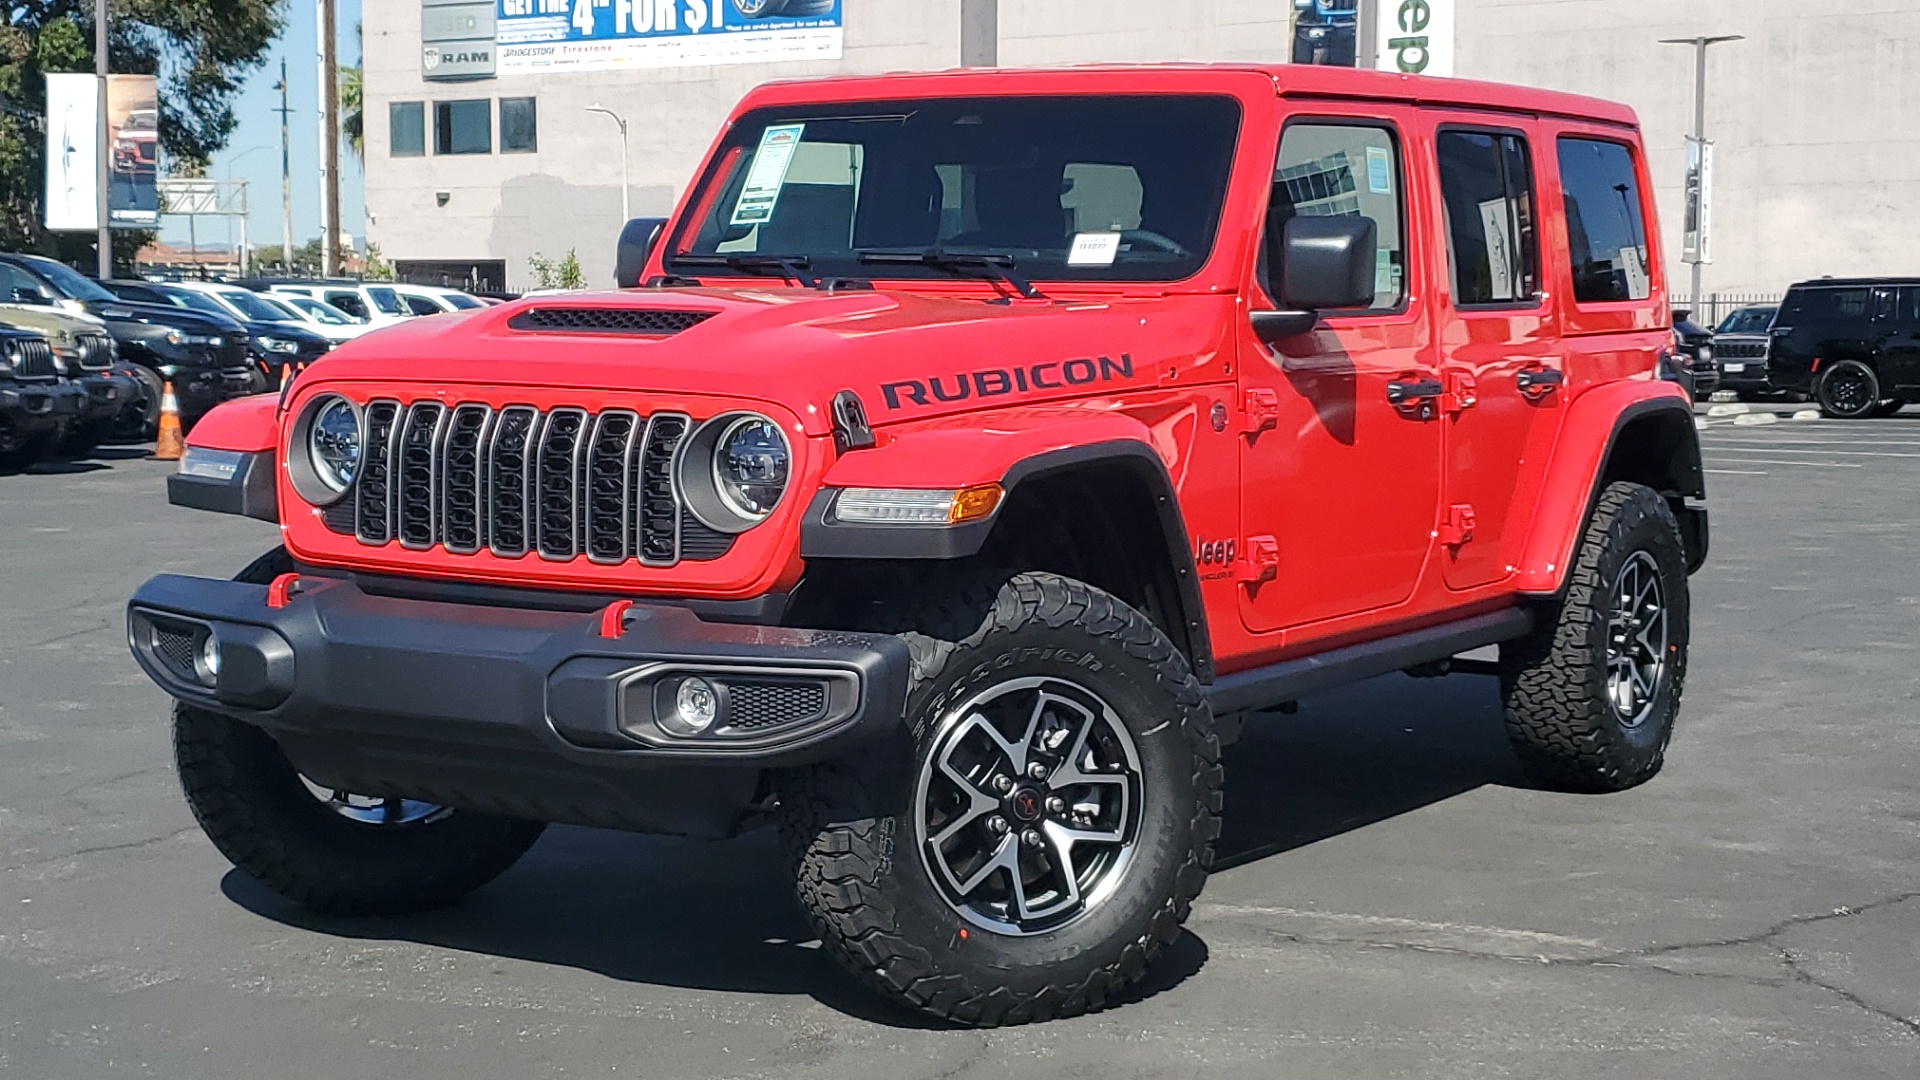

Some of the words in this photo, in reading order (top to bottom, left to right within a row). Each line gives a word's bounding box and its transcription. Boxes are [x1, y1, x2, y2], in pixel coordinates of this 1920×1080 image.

[615, 0, 677, 34] FOR
[442, 52, 489, 63] RAM
[503, 47, 555, 57] BRIDGESTONE
[881, 353, 1134, 410] RUBICON
[1195, 535, 1235, 567] Jeep
